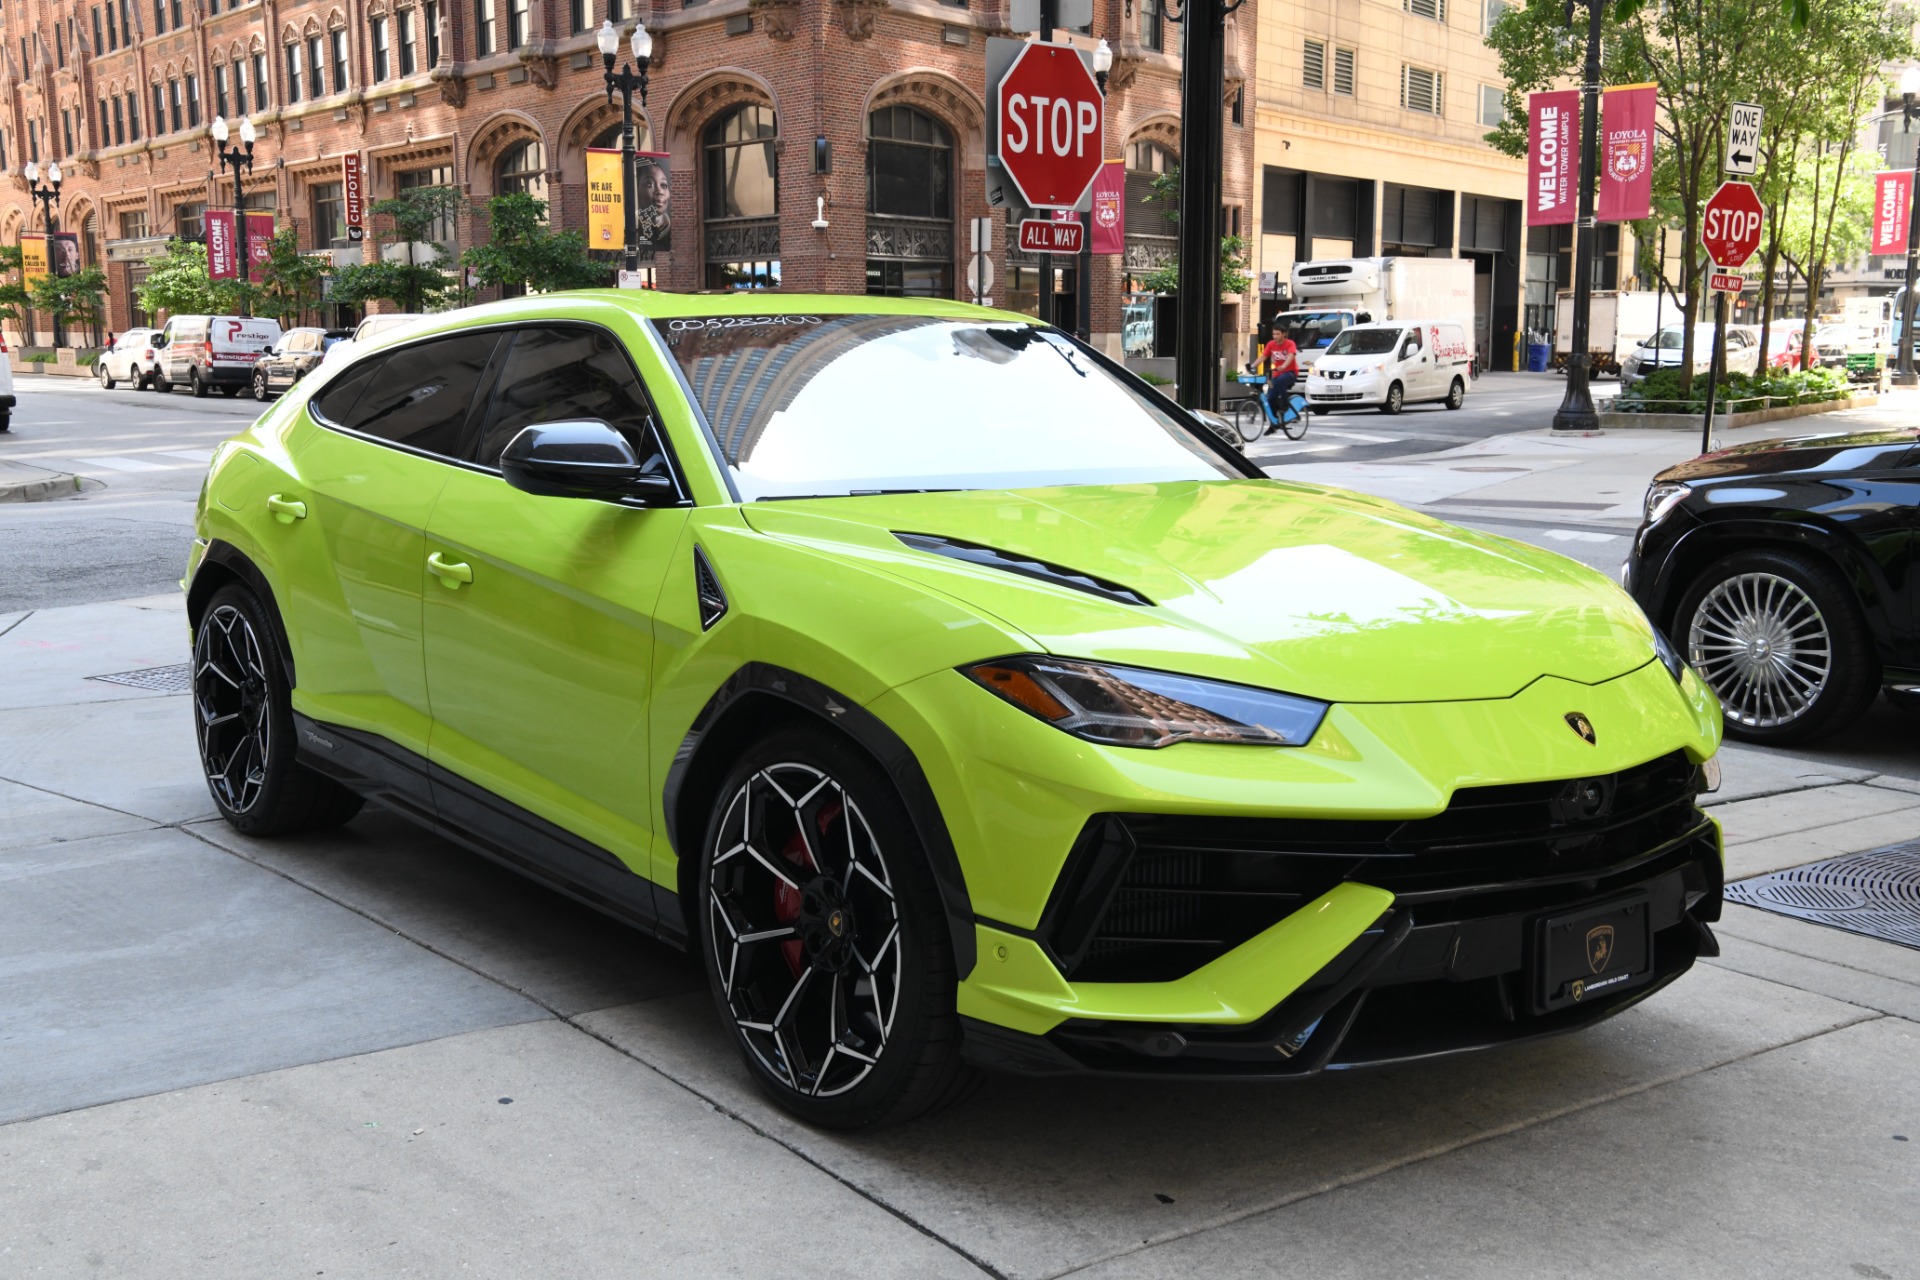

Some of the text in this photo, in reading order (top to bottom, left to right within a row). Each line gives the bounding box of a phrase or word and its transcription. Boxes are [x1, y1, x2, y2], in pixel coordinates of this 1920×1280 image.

[1006, 91, 1098, 158] STOP
[1734, 109, 1759, 128] ONE
[1609, 129, 1647, 140] LOYOLA
[1732, 128, 1757, 147] WAY
[1538, 106, 1558, 212] WELCOME
[1558, 111, 1570, 205] WATER TOWER CAMPUS
[347, 157, 359, 223] CHIPOTLE
[591, 182, 613, 191] WE ARE
[1897, 183, 1905, 205] CAMPUS
[591, 193, 621, 203] CALLED TO
[591, 204, 609, 213] SOLVE
[1879, 179, 1897, 246] WELCOME
[1706, 207, 1760, 242] STOP
[211, 218, 225, 274] WELCOME
[1026, 226, 1077, 246] ALL WAY
[1713, 277, 1742, 290] ALL WAY
[228, 321, 270, 343] Prestige
[1617, 973, 1629, 982] COAST
